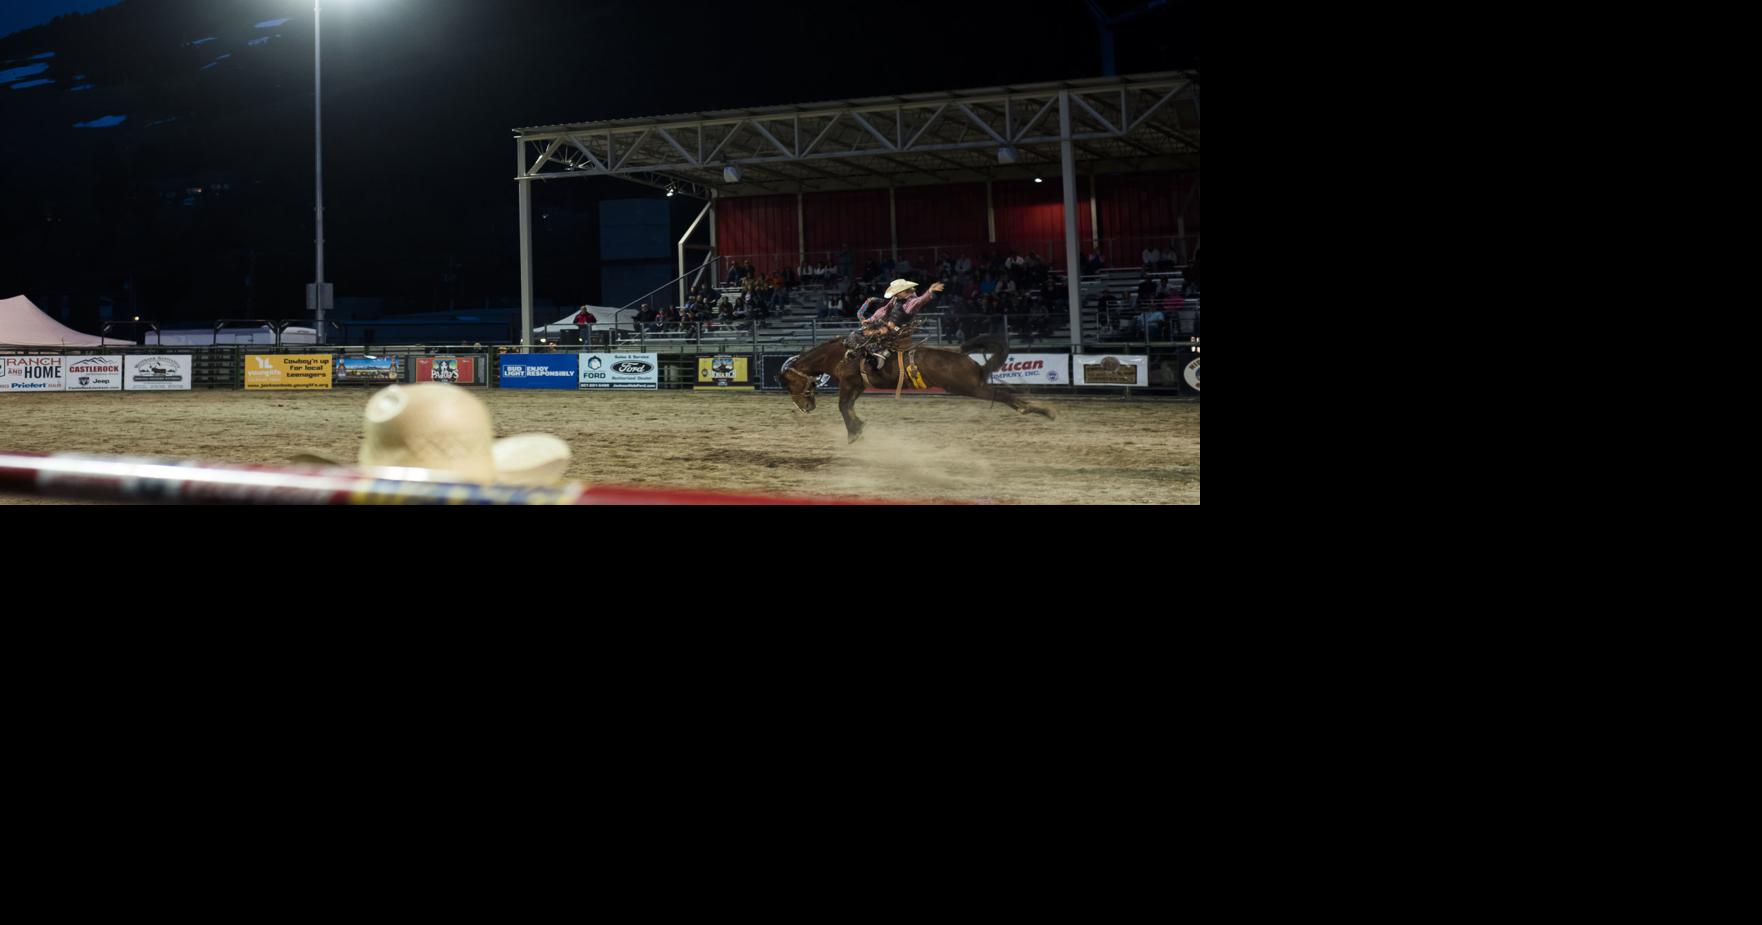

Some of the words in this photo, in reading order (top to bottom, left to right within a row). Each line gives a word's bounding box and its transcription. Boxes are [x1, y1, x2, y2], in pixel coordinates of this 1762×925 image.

[7, 358, 61, 366] RANCH
[618, 361, 646, 373] Ford
[24, 366, 61, 379] HOME
[70, 365, 119, 373] CASTLEROCK
